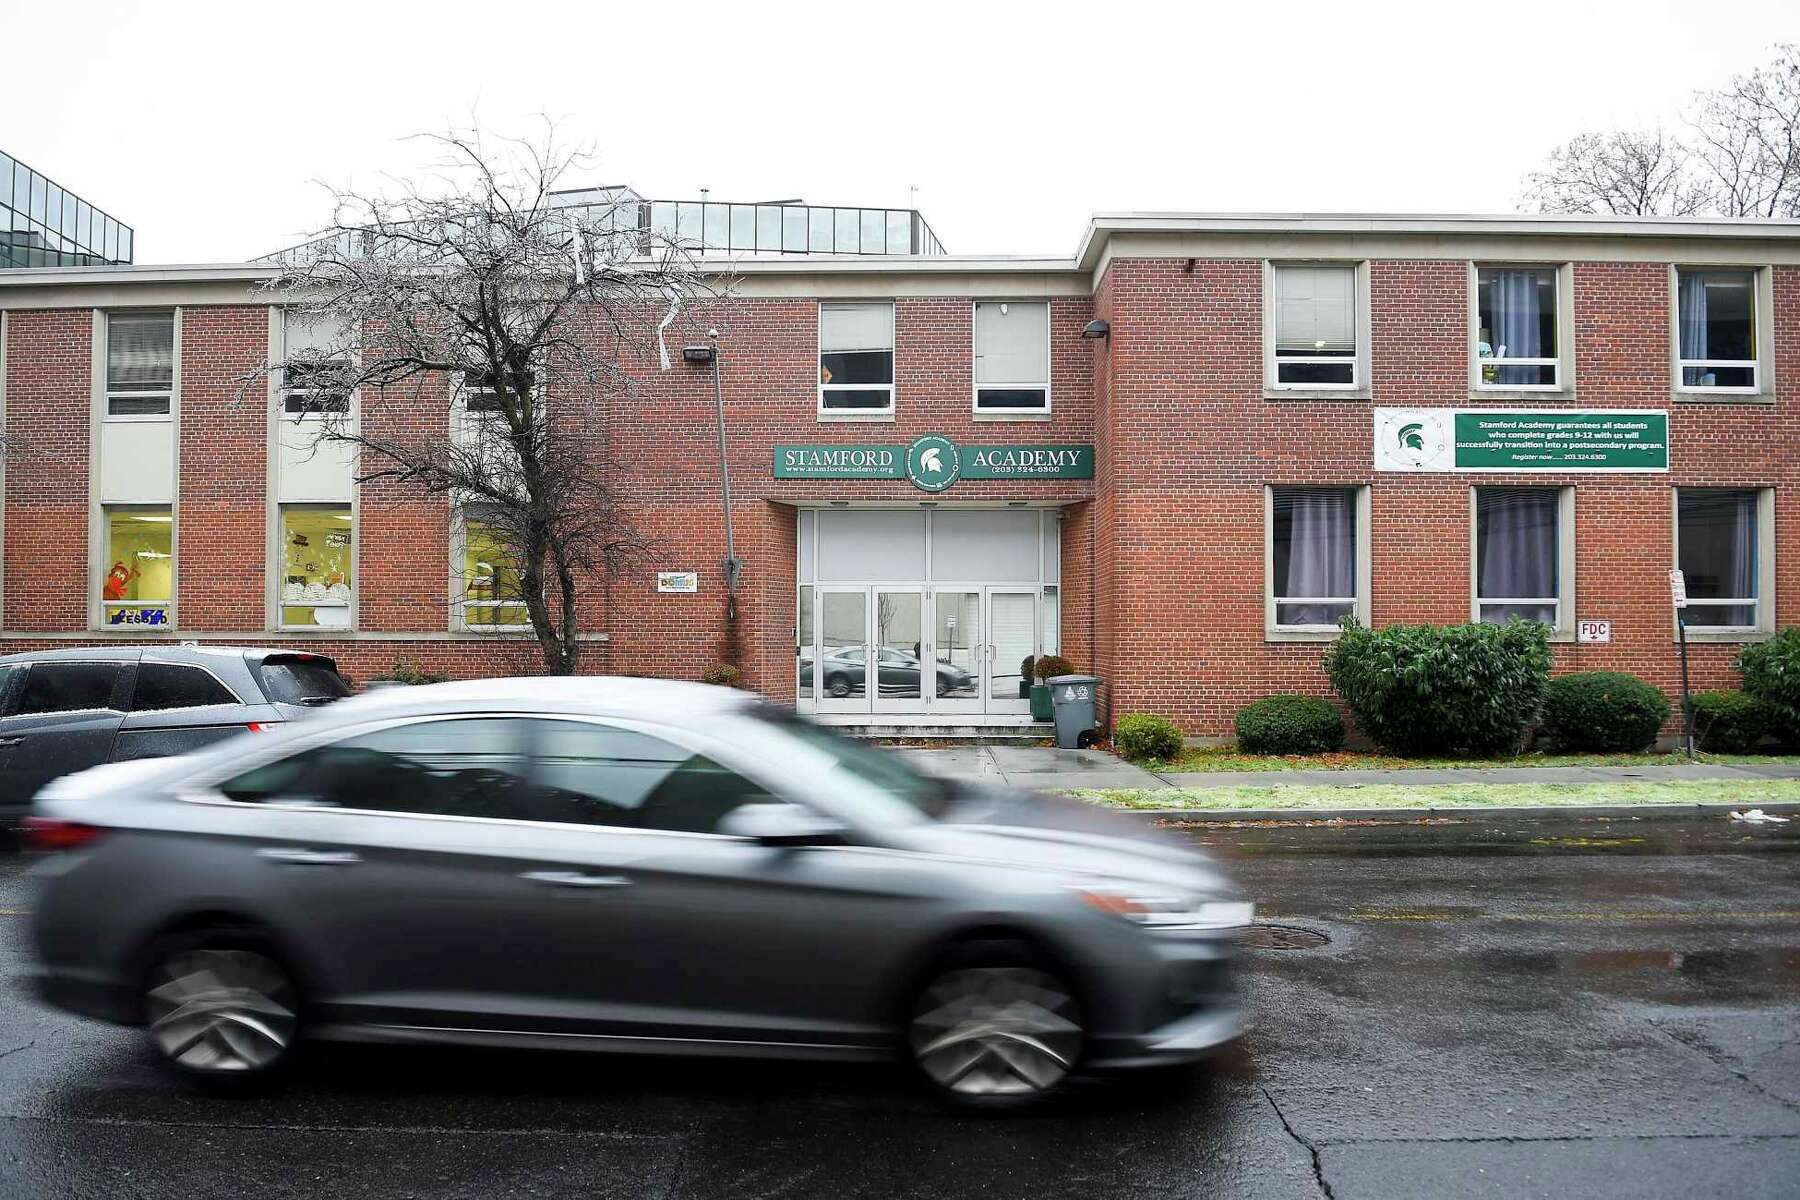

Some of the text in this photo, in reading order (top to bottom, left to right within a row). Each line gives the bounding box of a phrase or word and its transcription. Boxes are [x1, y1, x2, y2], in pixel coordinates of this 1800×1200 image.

[1479, 421, 1517, 429] Stamford
[1517, 421, 1555, 430] Academy
[1556, 422, 1600, 430] guarantees
[1507, 431, 1546, 439] complete
[1546, 431, 1574, 440] grades
[1456, 441, 1503, 449] successfully
[1569, 442, 1627, 450] postsecondary
[785, 449, 1081, 466] STAMFORD ACADEMY
[785, 466, 894, 474] www.stamfordacademy.org
[991, 466, 1015, 474] (203)
[1582, 623, 1606, 635] FDC
